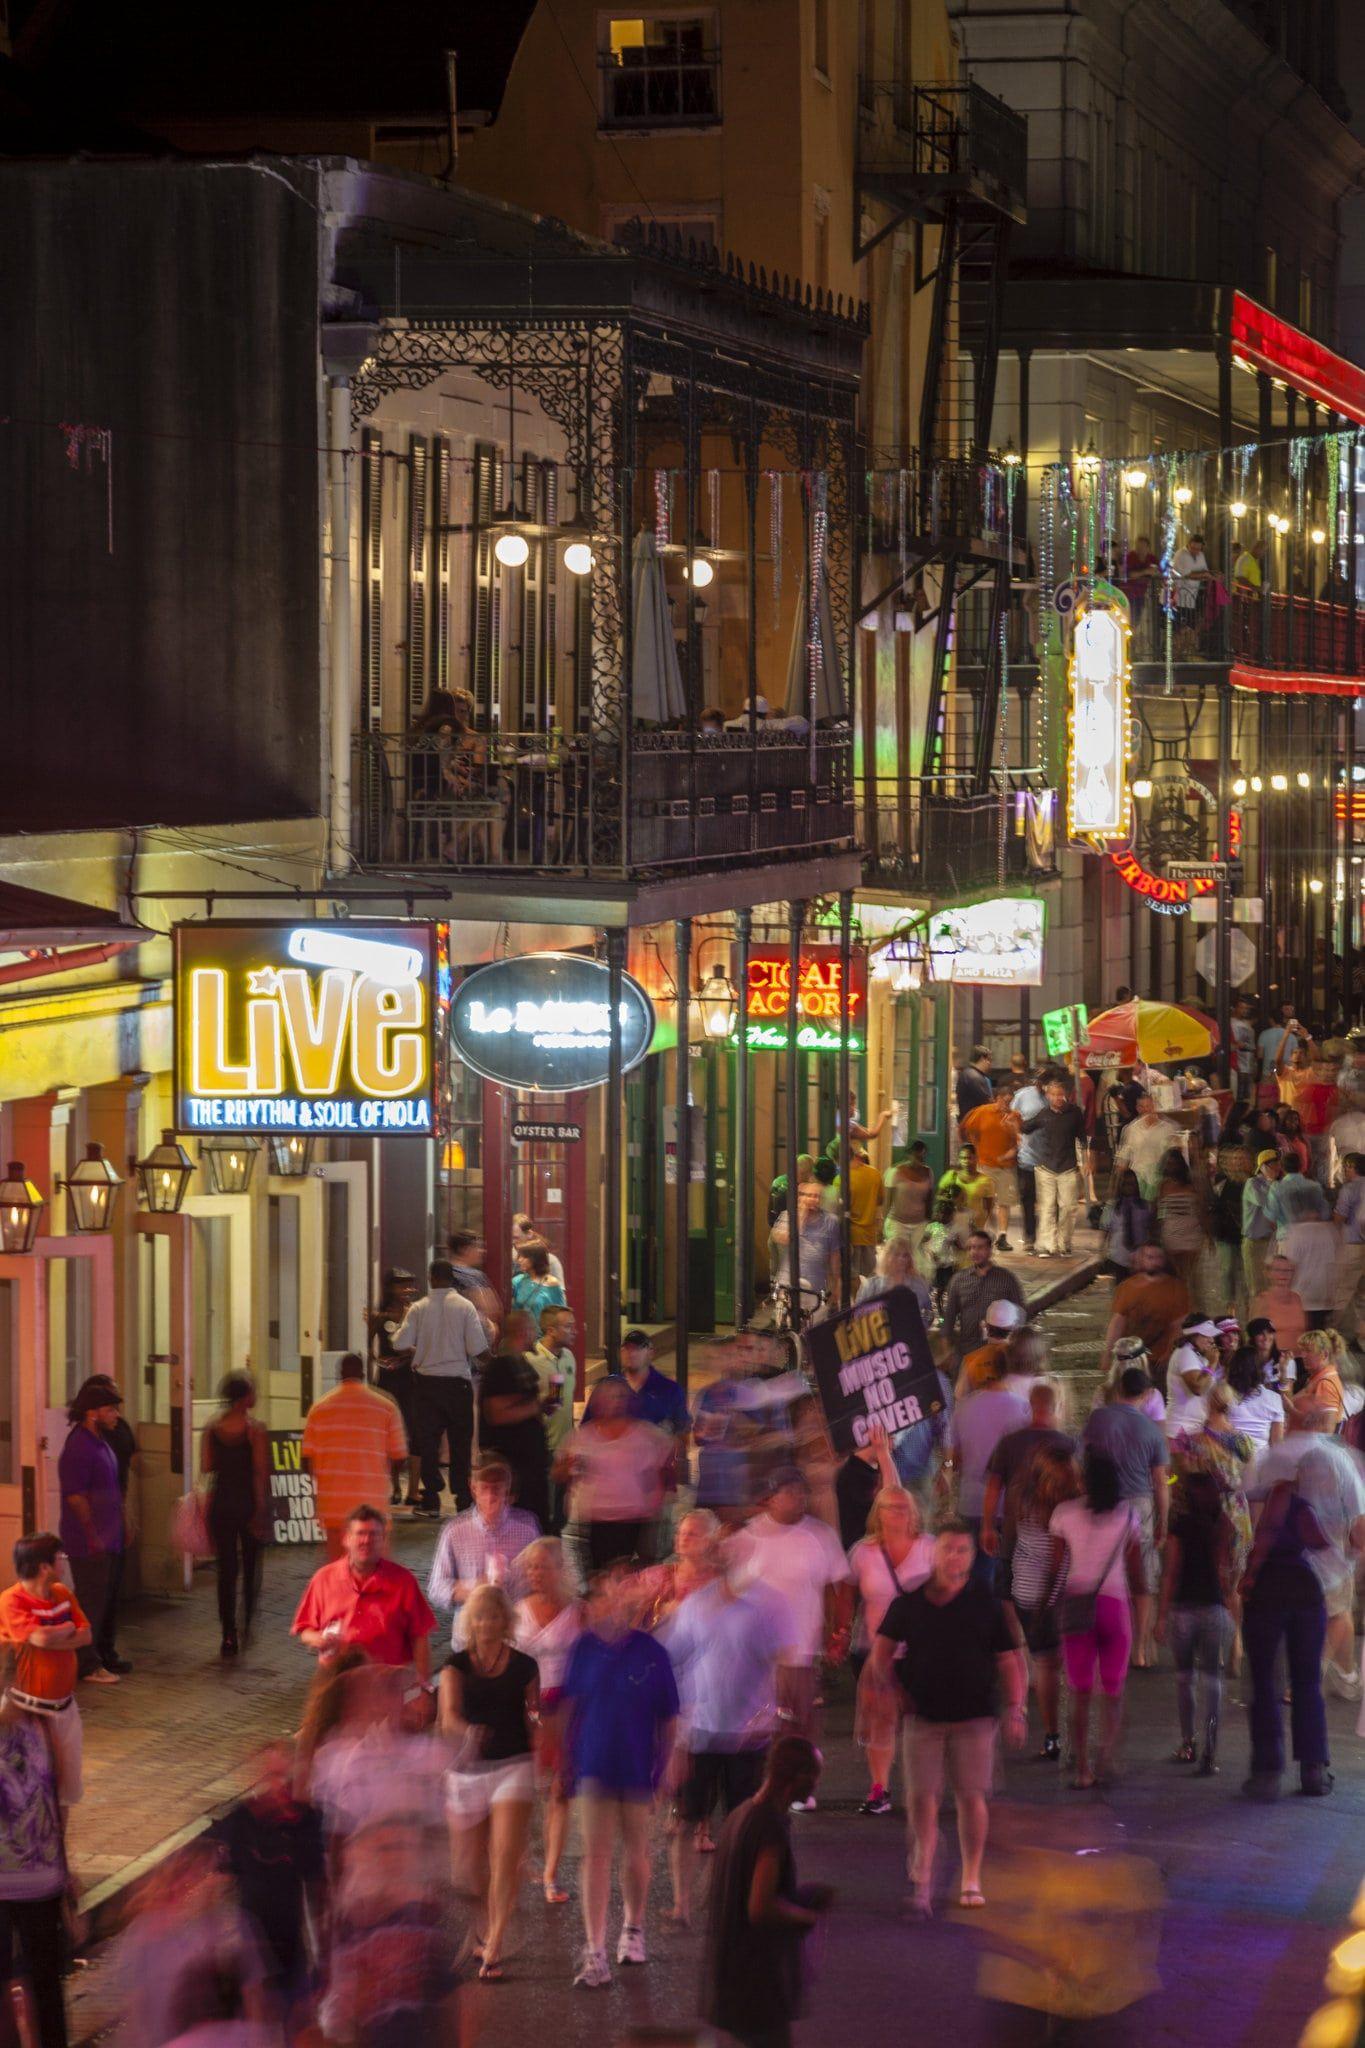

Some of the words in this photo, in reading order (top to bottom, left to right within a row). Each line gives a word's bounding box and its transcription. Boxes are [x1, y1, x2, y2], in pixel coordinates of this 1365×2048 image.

[1171, 868, 1224, 880] Iberville
[190, 1099, 222, 1125] THE
[224, 1099, 297, 1126] RHYTHM
[299, 1102, 313, 1127] &
[314, 1101, 358, 1128] SOUL
[360, 1100, 384, 1127] OF
[382, 1100, 430, 1126] NOLA
[514, 1125, 555, 1138] OYSTER
[558, 1127, 580, 1138] BAR
[838, 1342, 913, 1397] MUSIC
[863, 1377, 897, 1414] NO
[288, 1497, 315, 1519] NO
